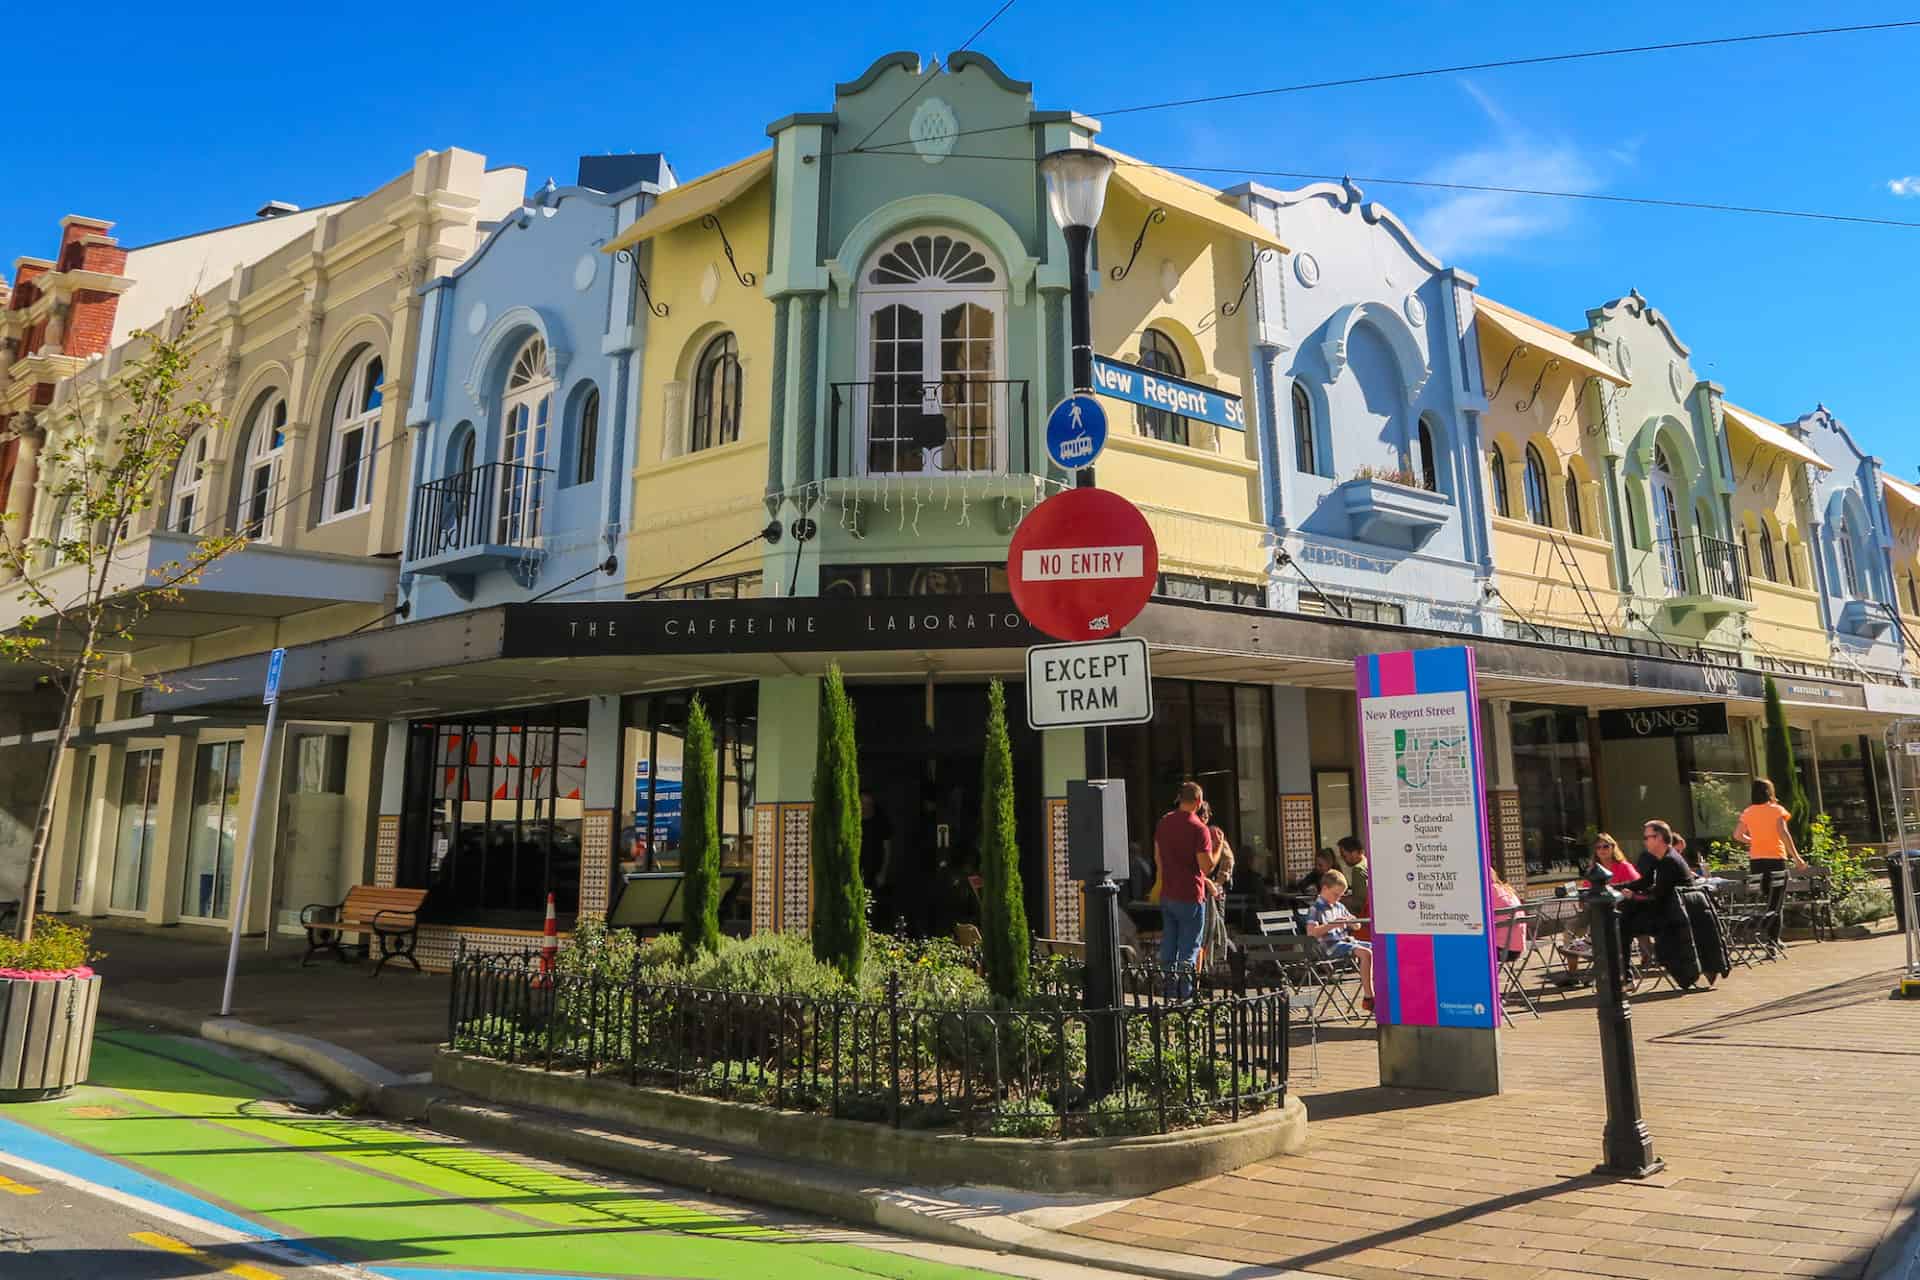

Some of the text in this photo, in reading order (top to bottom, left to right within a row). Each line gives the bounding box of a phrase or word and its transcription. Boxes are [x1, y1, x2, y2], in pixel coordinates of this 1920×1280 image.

[1094, 362, 1244, 424] New Regent St
[1040, 551, 1124, 575] NO ENTRY
[570, 613, 1032, 637] THE CAFFEINE LABORATO
[1045, 654, 1129, 682] EXCEPT
[1057, 685, 1119, 712] TRAM
[1366, 706, 1456, 722] New Regent Street
[1413, 814, 1454, 823] Cathedral
[1414, 824, 1444, 834] Square
[1415, 843, 1448, 852] Victoria
[1416, 853, 1445, 864] Square
[1418, 881, 1455, 892] City Mall
[1419, 901, 1436, 910] Bus
[1420, 911, 1470, 923] Interchange
